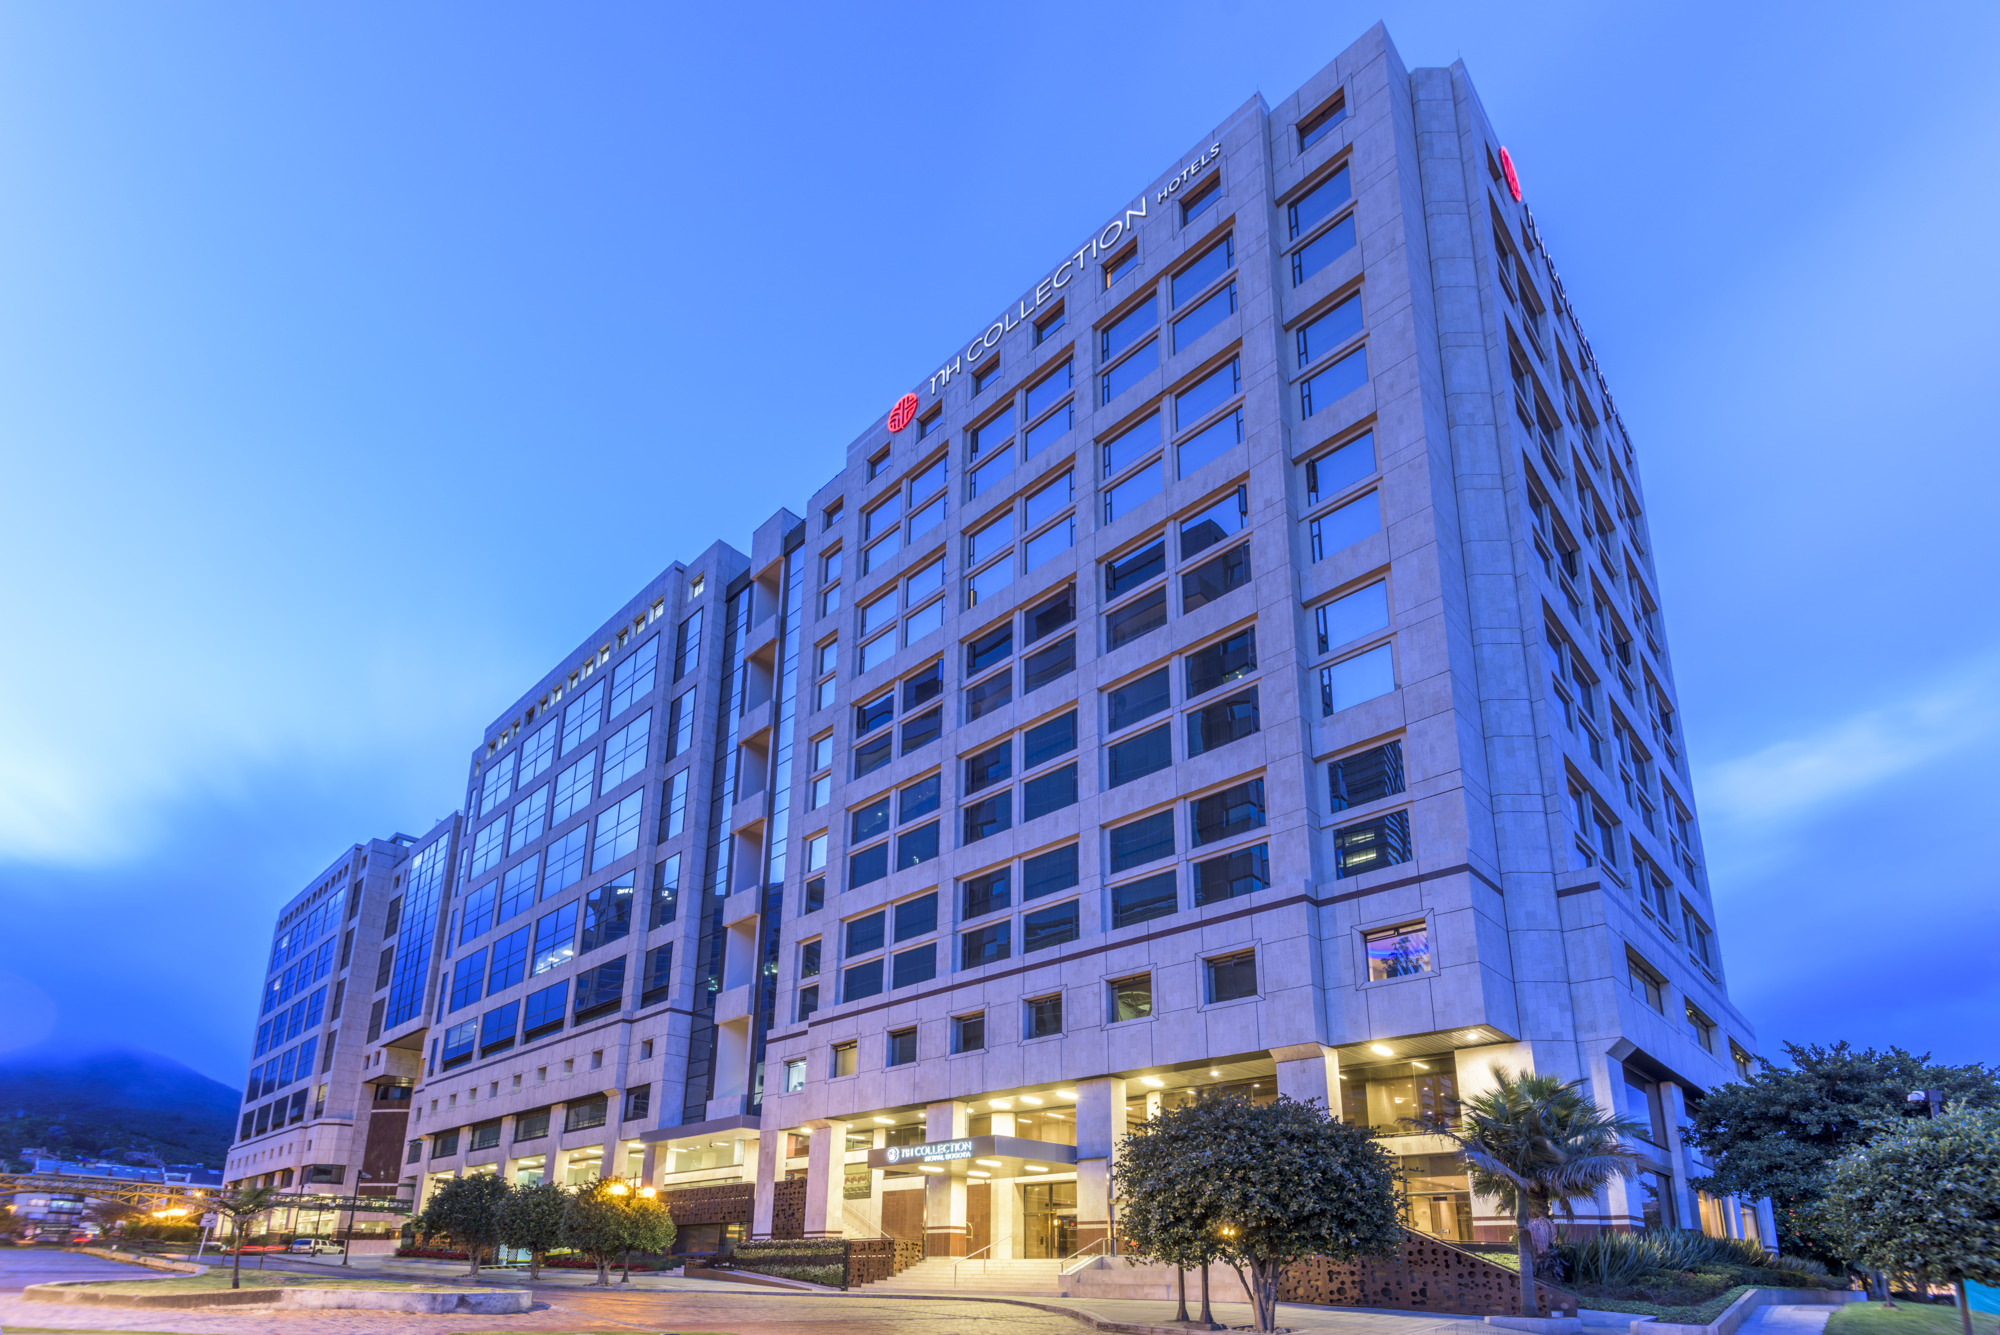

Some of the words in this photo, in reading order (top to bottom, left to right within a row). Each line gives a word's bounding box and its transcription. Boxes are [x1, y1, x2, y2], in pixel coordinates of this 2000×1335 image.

[967, 196, 1147, 362] COLLECTION
[1157, 142, 1220, 203] HOTELS
[914, 1141, 972, 1156] COLLECTION
